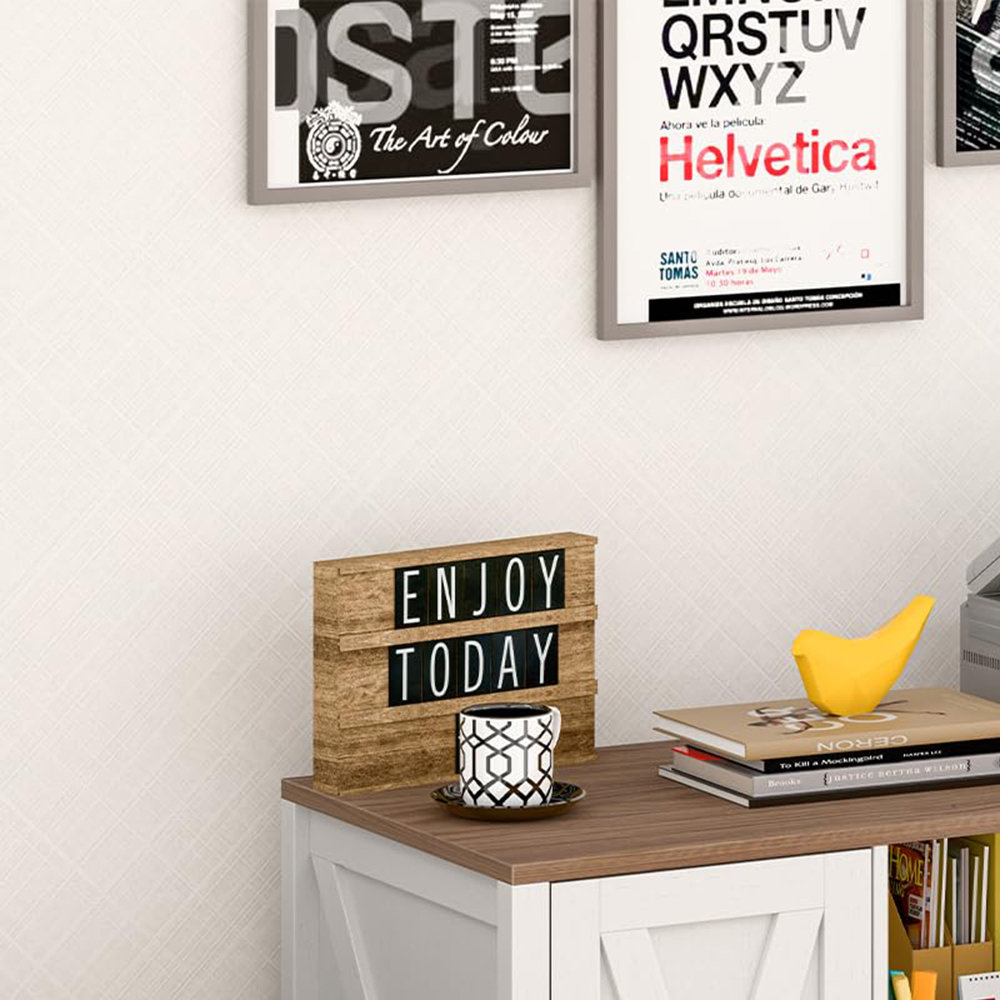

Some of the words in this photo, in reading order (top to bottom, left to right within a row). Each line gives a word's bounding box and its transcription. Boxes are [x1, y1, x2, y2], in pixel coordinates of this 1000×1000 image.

[662, 7, 867, 60] QRSTUV
[660, 61, 806, 110] WXYZ
[370, 124, 407, 151] The
[408, 125, 451, 152] Art
[437, 119, 486, 174] of
[484, 113, 549, 147] Colour
[660, 120, 692, 130] Ahora
[696, 121, 708, 129] ve
[711, 119, 720, 128] la
[660, 129, 877, 182] Helvetica
[660, 250, 698, 265] SANTO
[403, 554, 559, 624] ENJOY
[396, 632, 553, 701] TODAY
[817, 735, 908, 752] CERON
[821, 754, 884, 766] Mockingbird
